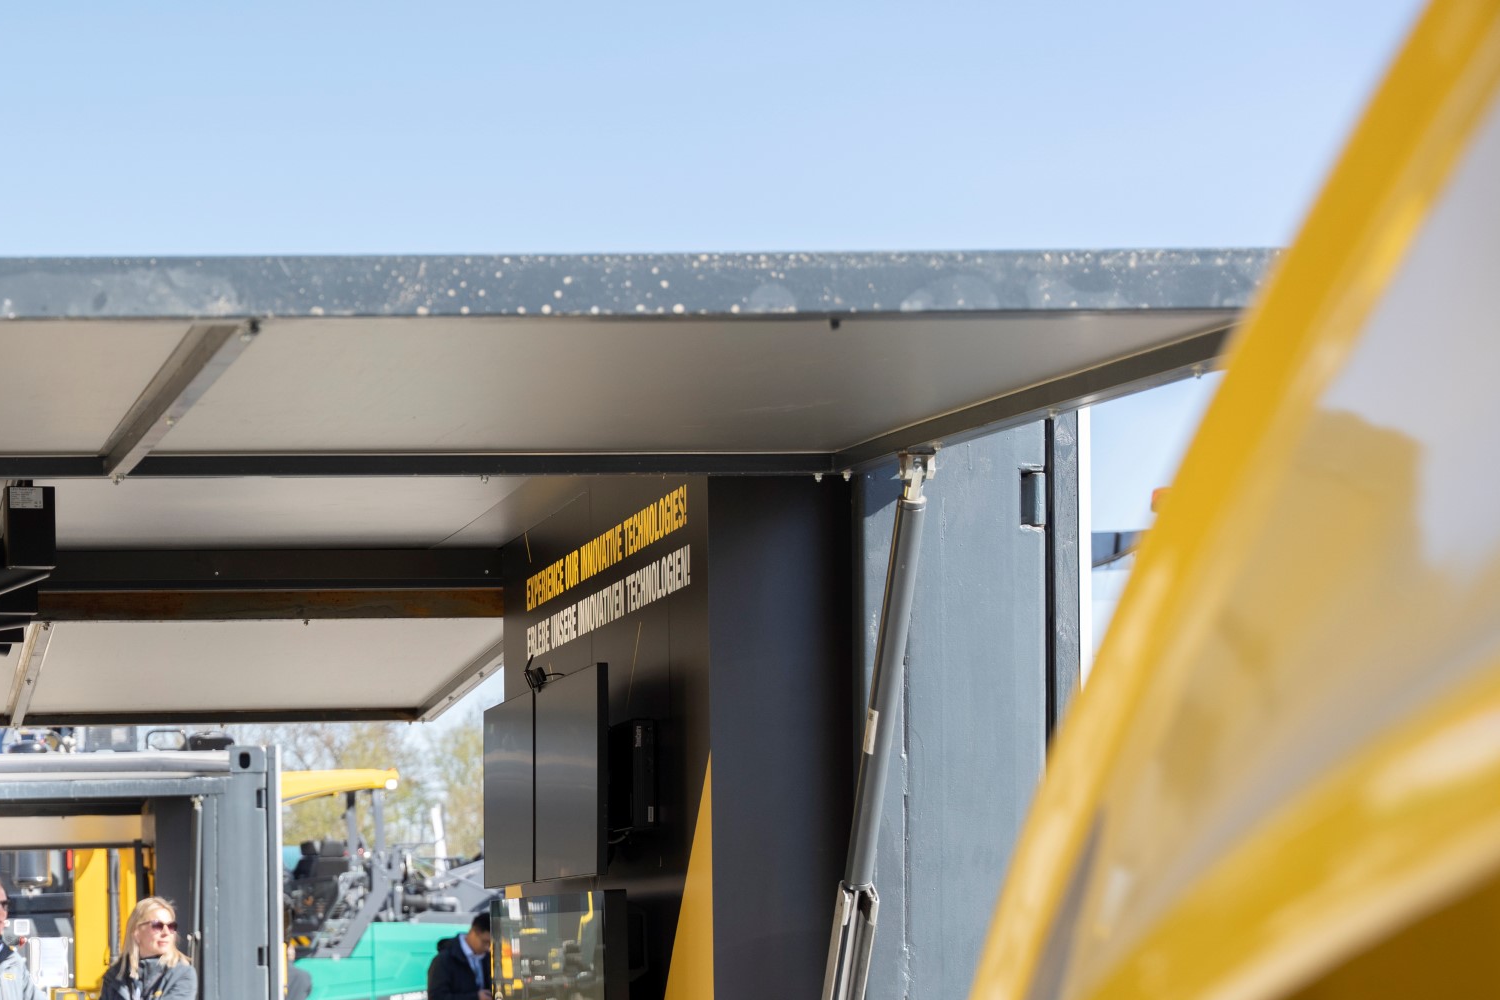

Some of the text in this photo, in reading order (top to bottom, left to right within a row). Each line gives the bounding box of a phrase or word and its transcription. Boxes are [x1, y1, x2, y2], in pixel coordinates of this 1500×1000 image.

[527, 484, 687, 612] EXPERIENCE OUR INNOVATIVE TECHNOLOGIES!
[527, 544, 690, 660] ERLEBE UNSERE INNOVATIVEN TECHNOLOGIEN!
